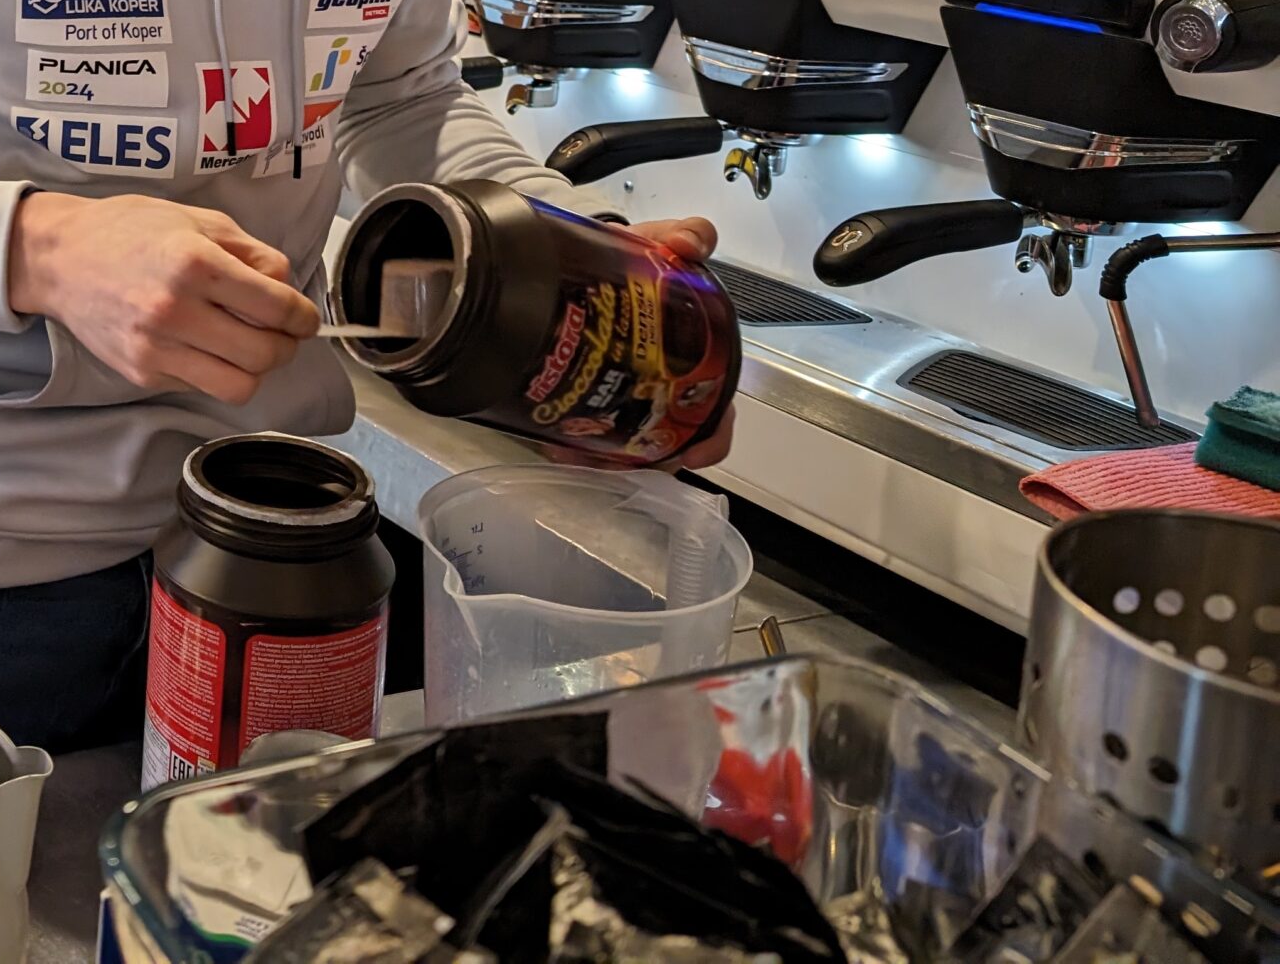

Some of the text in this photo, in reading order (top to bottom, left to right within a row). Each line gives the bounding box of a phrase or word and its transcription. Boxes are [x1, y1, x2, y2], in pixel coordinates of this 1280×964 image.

[65, 22, 163, 42] Port of Koper
[39, 57, 156, 75] PLANICA
[38, 81, 94, 101] 2024
[61, 119, 172, 169] ELES
[526, 303, 586, 402] ristora
